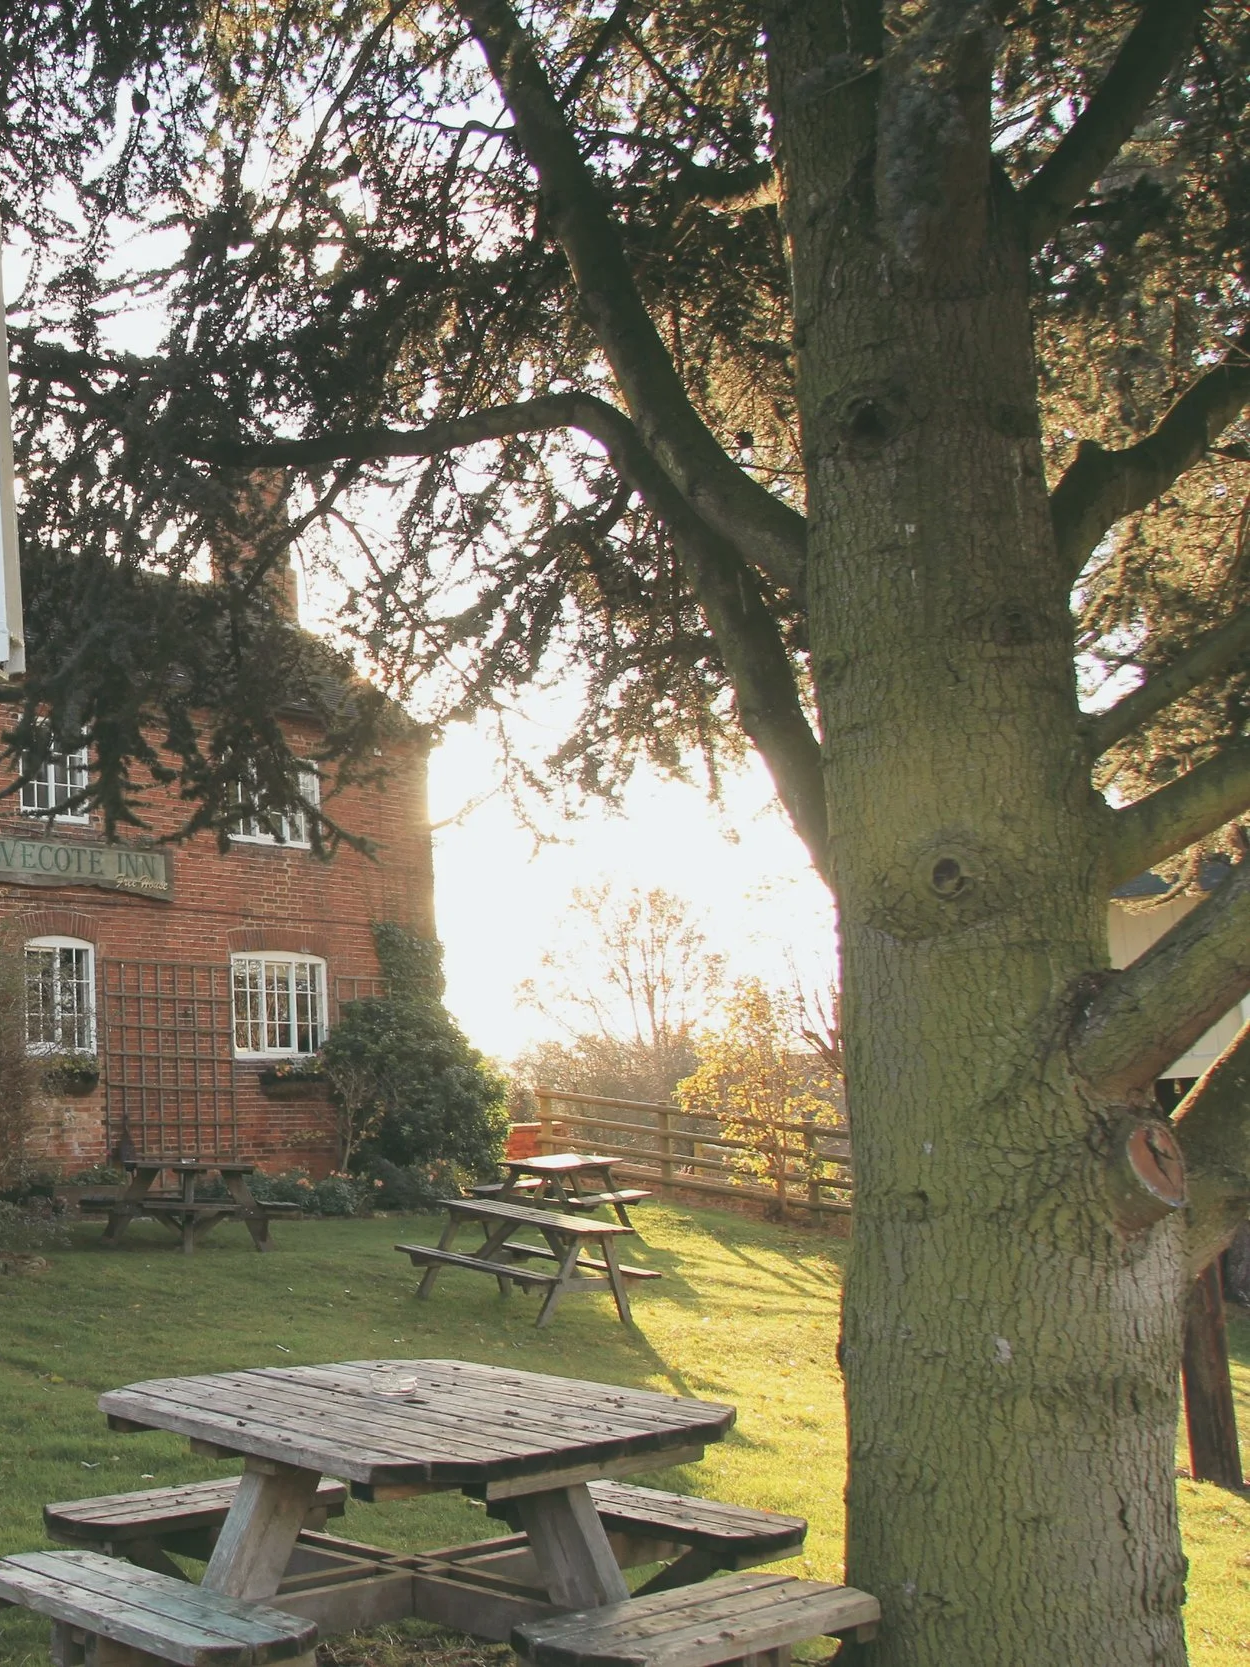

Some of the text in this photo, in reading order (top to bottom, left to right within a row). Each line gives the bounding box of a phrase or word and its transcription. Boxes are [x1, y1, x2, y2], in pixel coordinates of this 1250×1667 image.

[117, 852, 156, 879] INN
[114, 873, 169, 891] Free House
